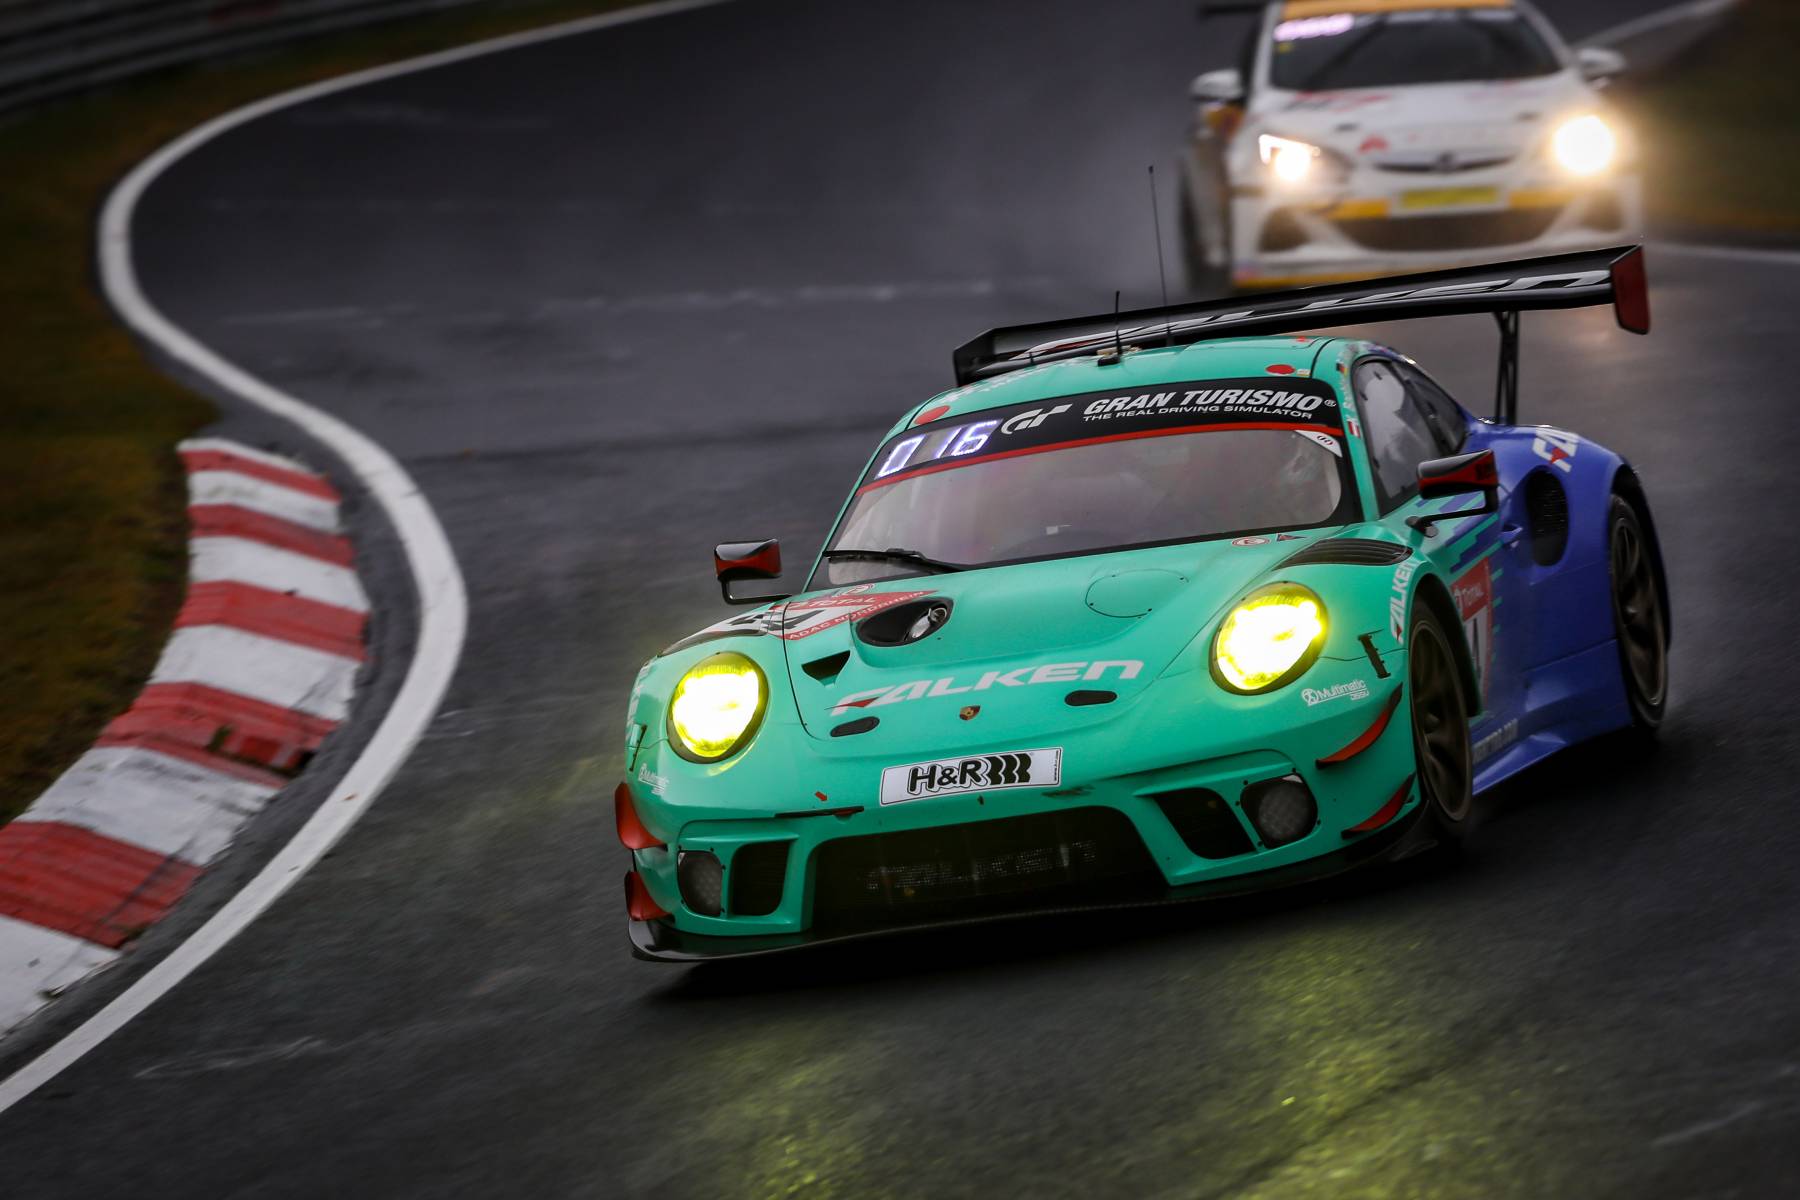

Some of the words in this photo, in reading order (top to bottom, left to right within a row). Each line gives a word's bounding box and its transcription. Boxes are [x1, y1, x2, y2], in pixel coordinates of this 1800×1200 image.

[1083, 391, 1177, 416] GRAN
[1178, 389, 1323, 411] TURISMO
[1083, 413, 1113, 422] THE
[1116, 409, 1154, 418] REAL
[1158, 405, 1220, 414] DRIVING
[1224, 405, 1313, 420] SIMULATOR
[789, 621, 832, 641] ADAC
[830, 660, 1144, 717] FALKEN
[1317, 679, 1368, 700] Multimatic
[908, 758, 984, 793] H&R
